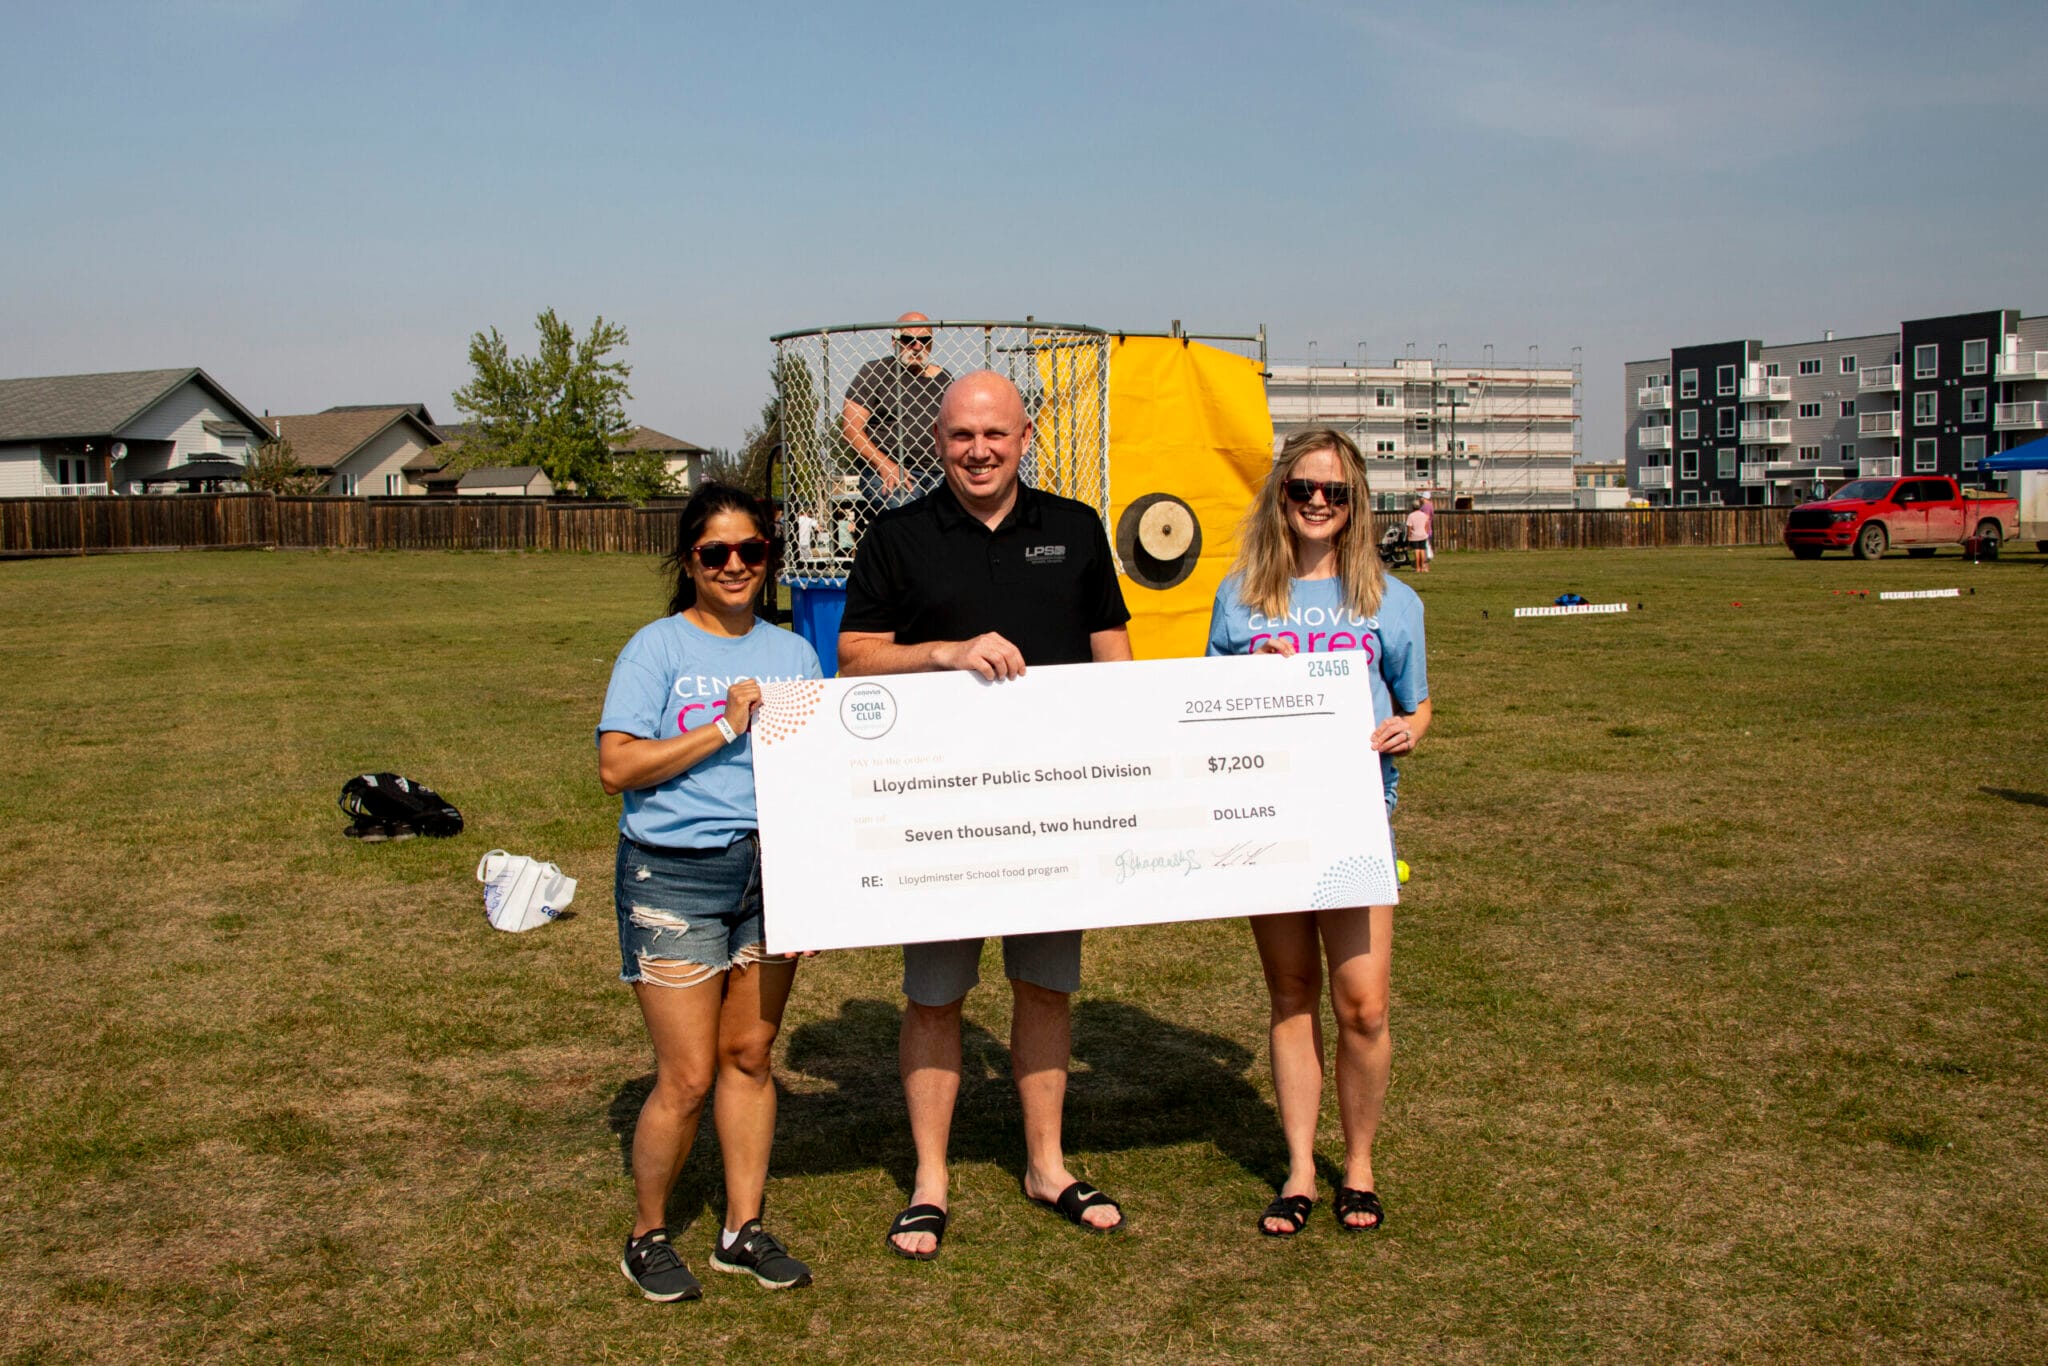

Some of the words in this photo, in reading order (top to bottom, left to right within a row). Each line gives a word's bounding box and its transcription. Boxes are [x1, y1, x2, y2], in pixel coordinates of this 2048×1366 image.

[1308, 659, 1350, 678] 23456
[851, 702, 886, 712] SOCIAL
[1185, 700, 1222, 714] 2024
[1226, 695, 1314, 712] SEPTEMBER
[1317, 693, 1325, 706] 7
[856, 711, 882, 721] CLUB
[1208, 754, 1265, 773] $7,200
[873, 776, 978, 794] Lloydminster
[982, 770, 1031, 785] Public
[1034, 767, 1088, 782] School
[1091, 763, 1152, 779] Division
[1214, 806, 1276, 820] DOLLARS
[905, 829, 953, 842] Seven
[957, 821, 1036, 839] thousand,
[1040, 820, 1069, 833] two
[1073, 814, 1138, 831] hundred
[861, 876, 884, 888] RE:
[899, 872, 964, 886] Lloydminster
[966, 869, 1000, 880] School
[1002, 867, 1026, 878] food
[1027, 864, 1069, 878] program
